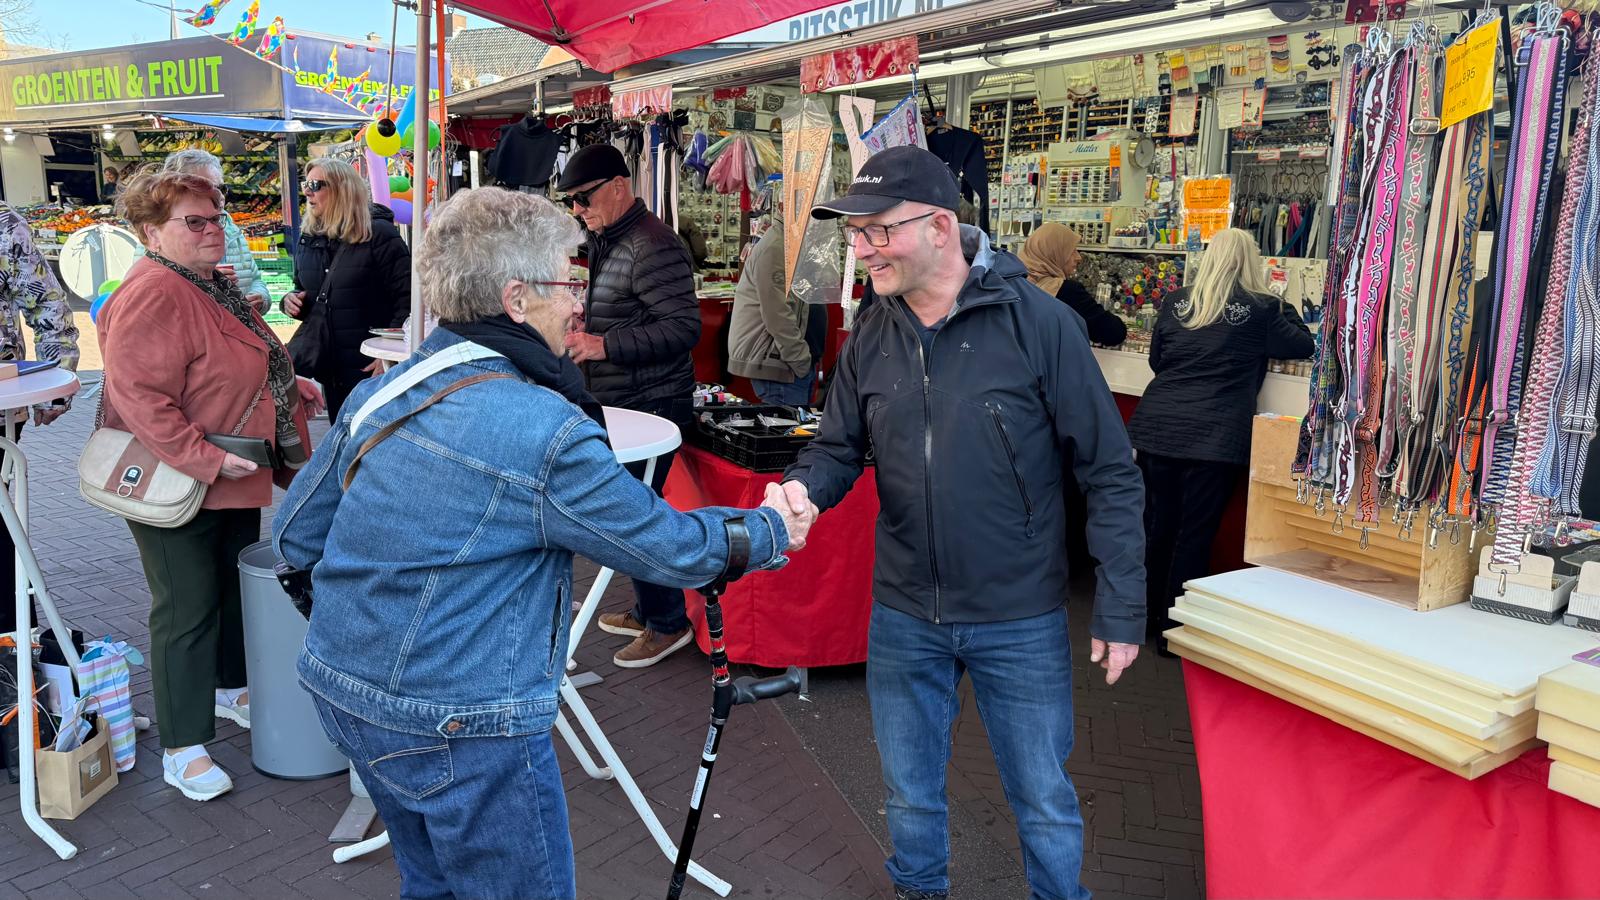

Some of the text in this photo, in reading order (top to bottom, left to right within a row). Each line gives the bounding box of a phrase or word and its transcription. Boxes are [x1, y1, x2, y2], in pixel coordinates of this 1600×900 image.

[12, 56, 223, 106] GROENTEN & FRUIT
[294, 70, 384, 94] GROENEN
[400, 84, 440, 101] FIT
